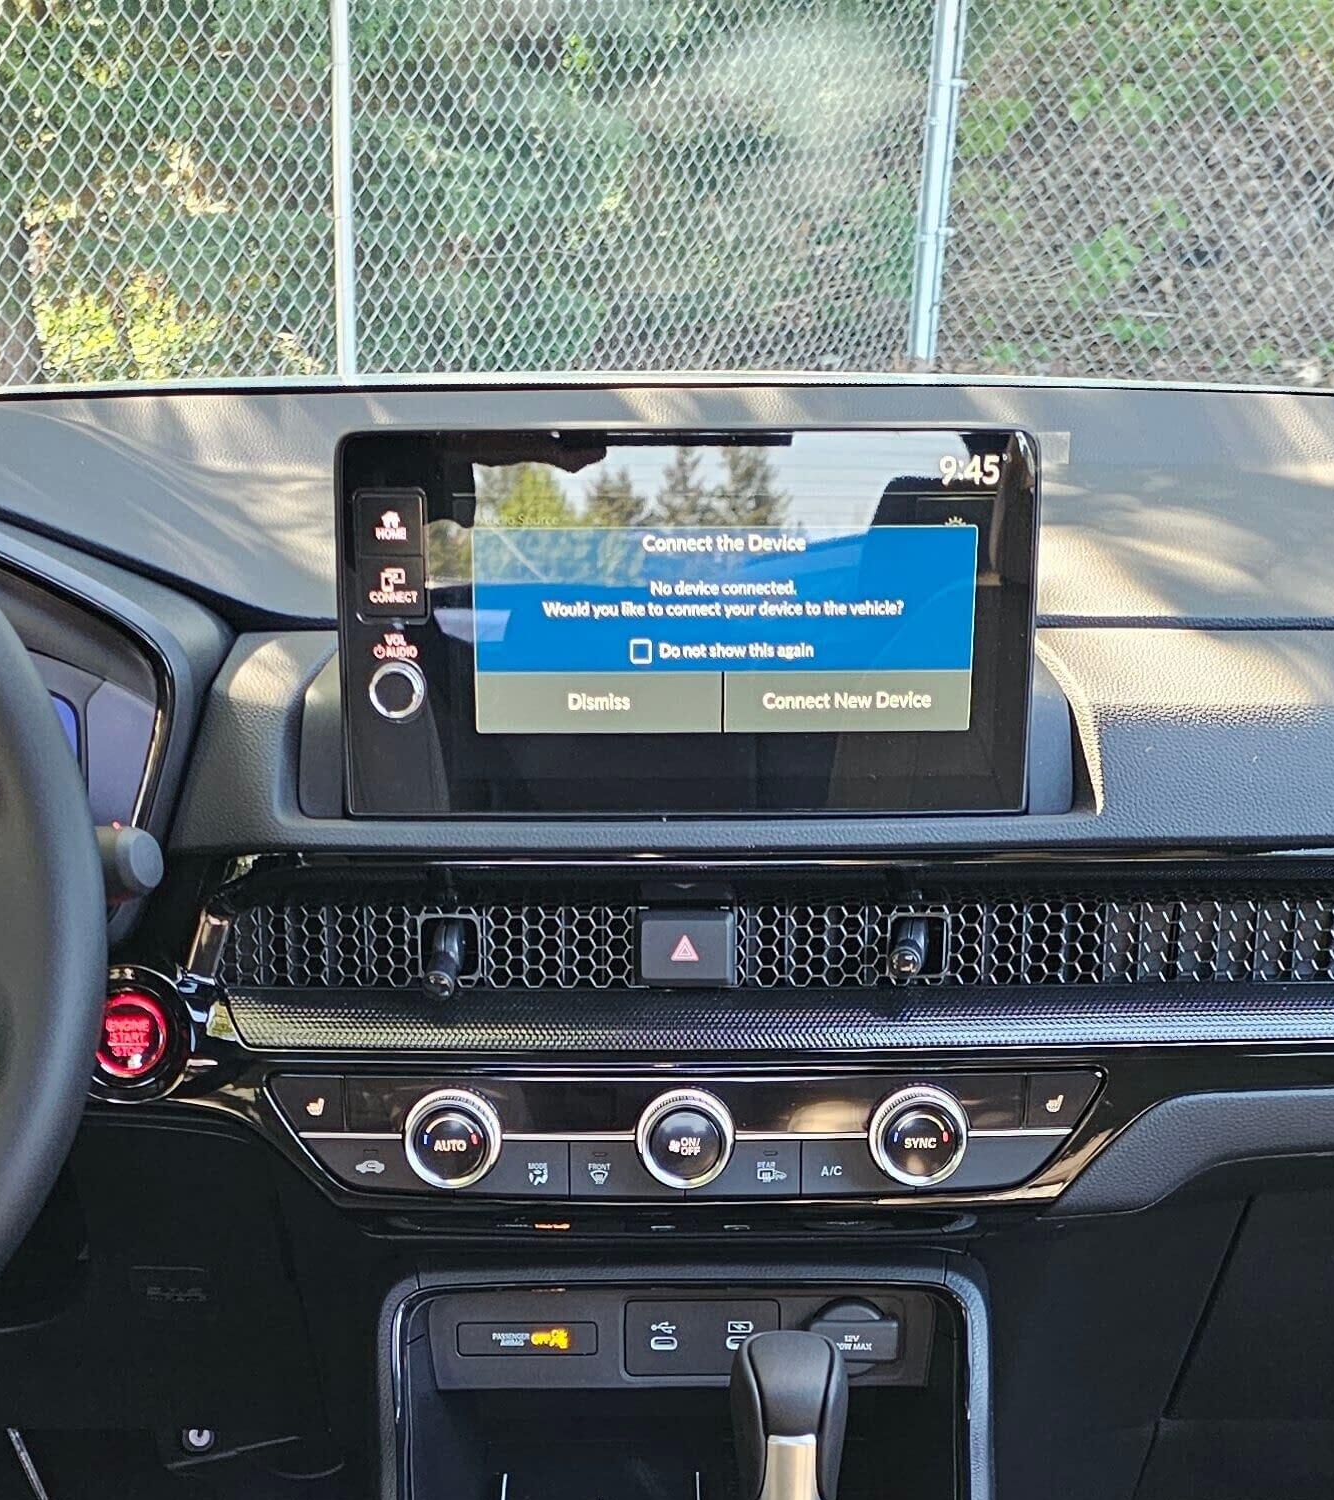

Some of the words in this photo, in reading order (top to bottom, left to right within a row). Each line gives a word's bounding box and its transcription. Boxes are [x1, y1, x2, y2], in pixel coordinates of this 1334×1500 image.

[940, 454, 1000, 486] 9:45
[476, 515, 515, 525] Audo
[518, 514, 560, 525] Source
[375, 527, 407, 540] HOME
[642, 535, 713, 552] Connect
[716, 534, 744, 552] the
[748, 534, 807, 552] Device
[650, 581, 673, 596] No
[674, 580, 720, 596] device
[721, 580, 797, 596] connected.
[369, 591, 418, 604] CONNECT
[542, 601, 590, 617] Would
[592, 605, 618, 620] you
[621, 601, 646, 617] like
[648, 603, 664, 616] to
[666, 602, 722, 617] connect
[724, 603, 756, 619] your
[758, 601, 803, 616] device
[806, 601, 821, 616] to
[823, 600, 848, 616] the
[850, 600, 905, 616] vehicle?
[384, 634, 407, 646] VOL
[386, 645, 418, 658] AUDIO
[659, 642, 679, 658] Do
[683, 644, 706, 658] not
[709, 643, 747, 658] show
[749, 643, 774, 658] this
[777, 643, 814, 660] again
[567, 693, 631, 711] Dismiss
[762, 693, 830, 710] Connect
[834, 693, 871, 709] New
[876, 691, 932, 709] Device
[106, 1019, 149, 1032] ENGINE
[109, 1032, 146, 1043] START
[433, 1140, 467, 1152] AUTO
[681, 1137, 701, 1147] ON/
[904, 1137, 937, 1149] SYNC
[681, 1146, 701, 1156] OFF
[821, 1165, 843, 1176] A/C
[492, 1332, 530, 1340] PASSENGER
[844, 1335, 860, 1343] 12V
[836, 1343, 852, 1351] 0W
[853, 1343, 872, 1351] MAX
